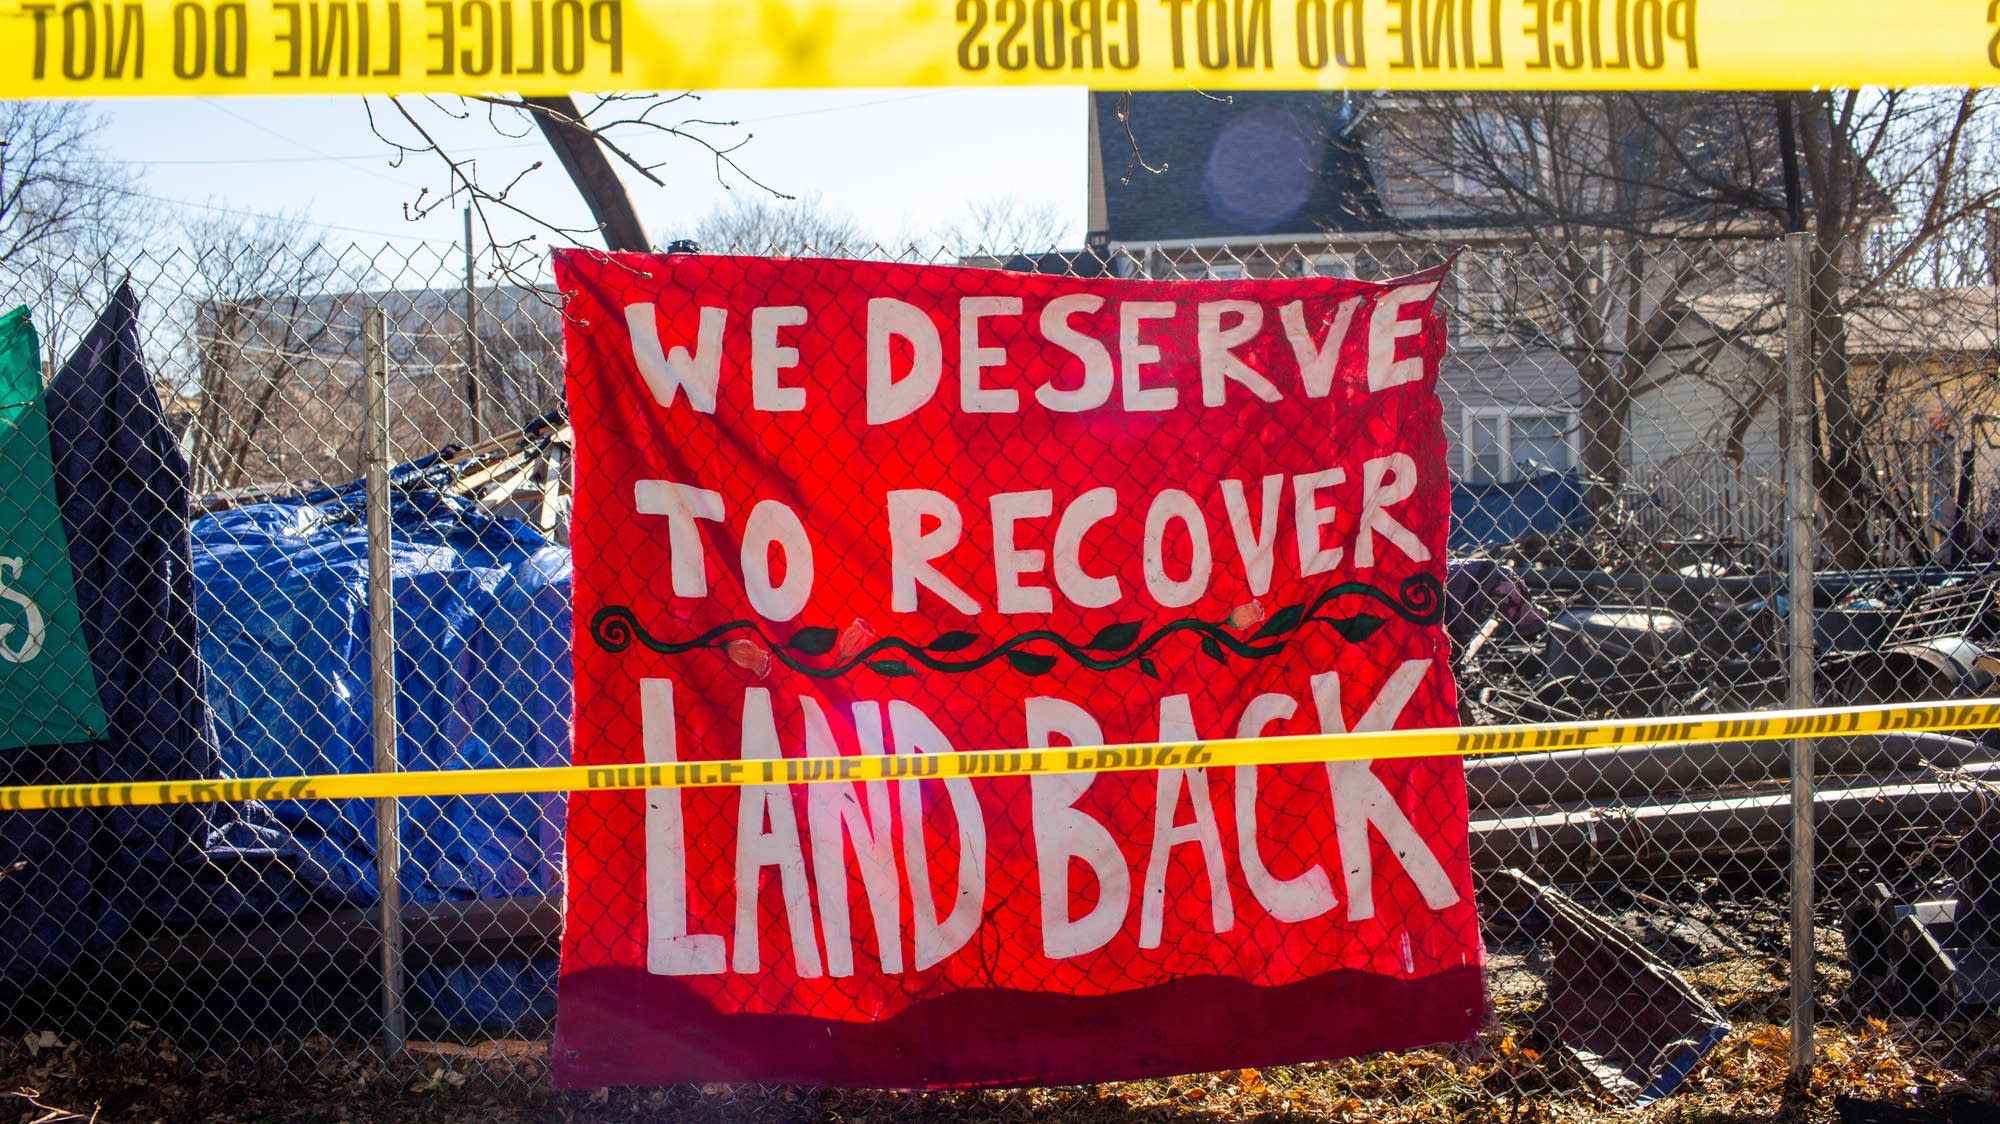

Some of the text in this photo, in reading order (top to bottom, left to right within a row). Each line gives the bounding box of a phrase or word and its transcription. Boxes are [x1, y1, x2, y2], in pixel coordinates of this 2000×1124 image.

[624, 281, 1440, 425] WE DESERVE
[635, 453, 1431, 621] TO RECOVER
[640, 659, 1460, 978] LAND BACK
